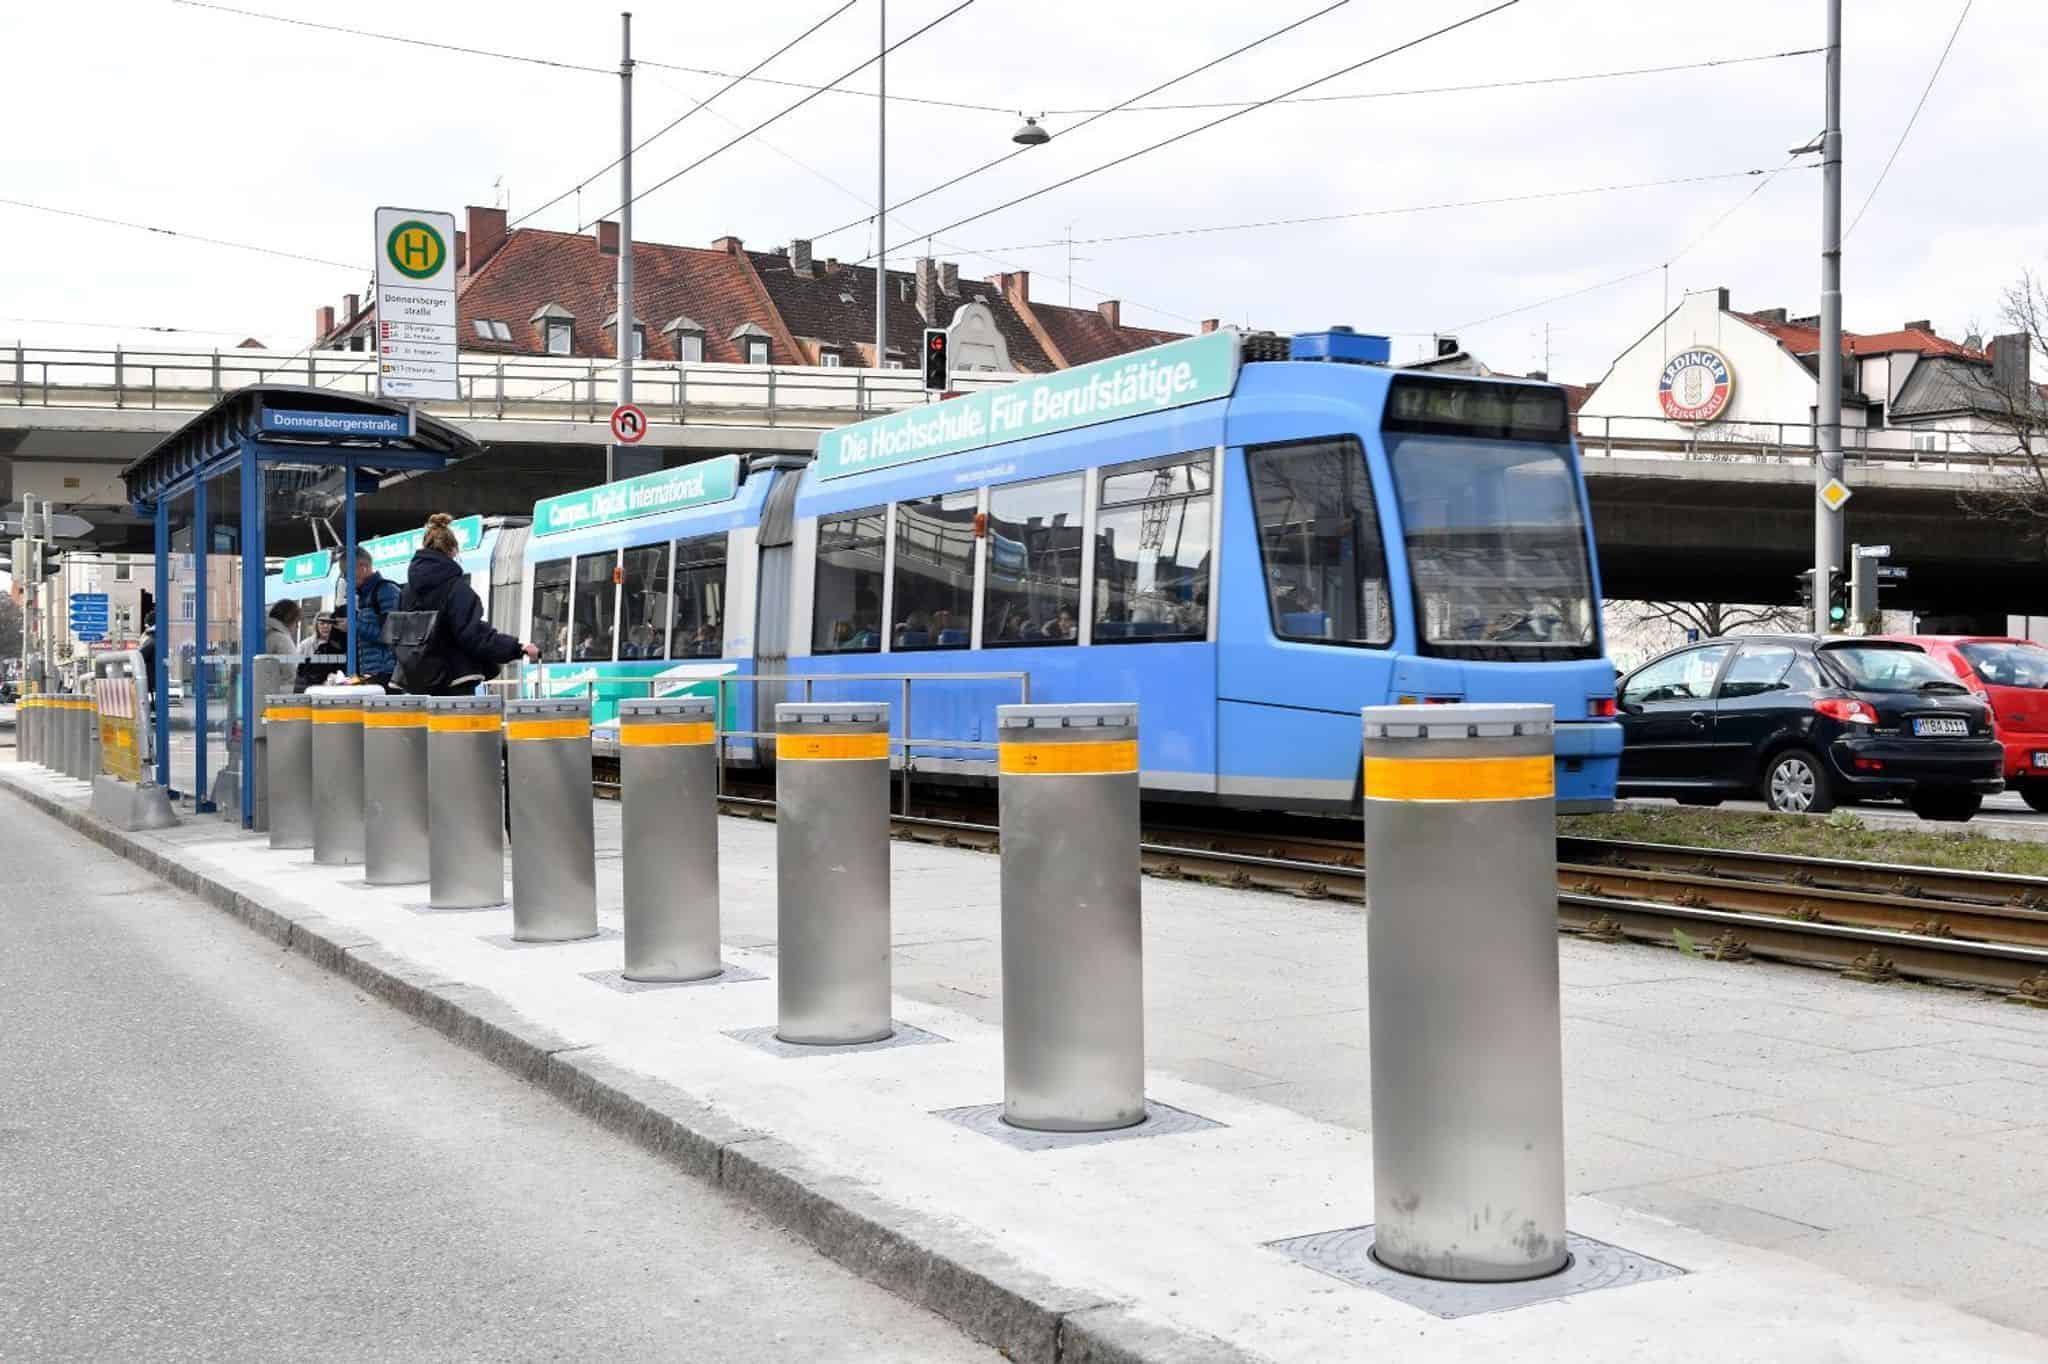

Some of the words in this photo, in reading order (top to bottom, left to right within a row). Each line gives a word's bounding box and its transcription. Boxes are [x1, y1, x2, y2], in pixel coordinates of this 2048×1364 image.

[405, 233, 429, 267] H
[1662, 353, 1725, 384] ERDINGER
[274, 414, 398, 431] Donnersbergerstraße
[840, 432, 867, 465] Die
[870, 407, 986, 457] Hochschule.
[991, 393, 1028, 434] Für
[1032, 359, 1199, 426] Berufstätige.
